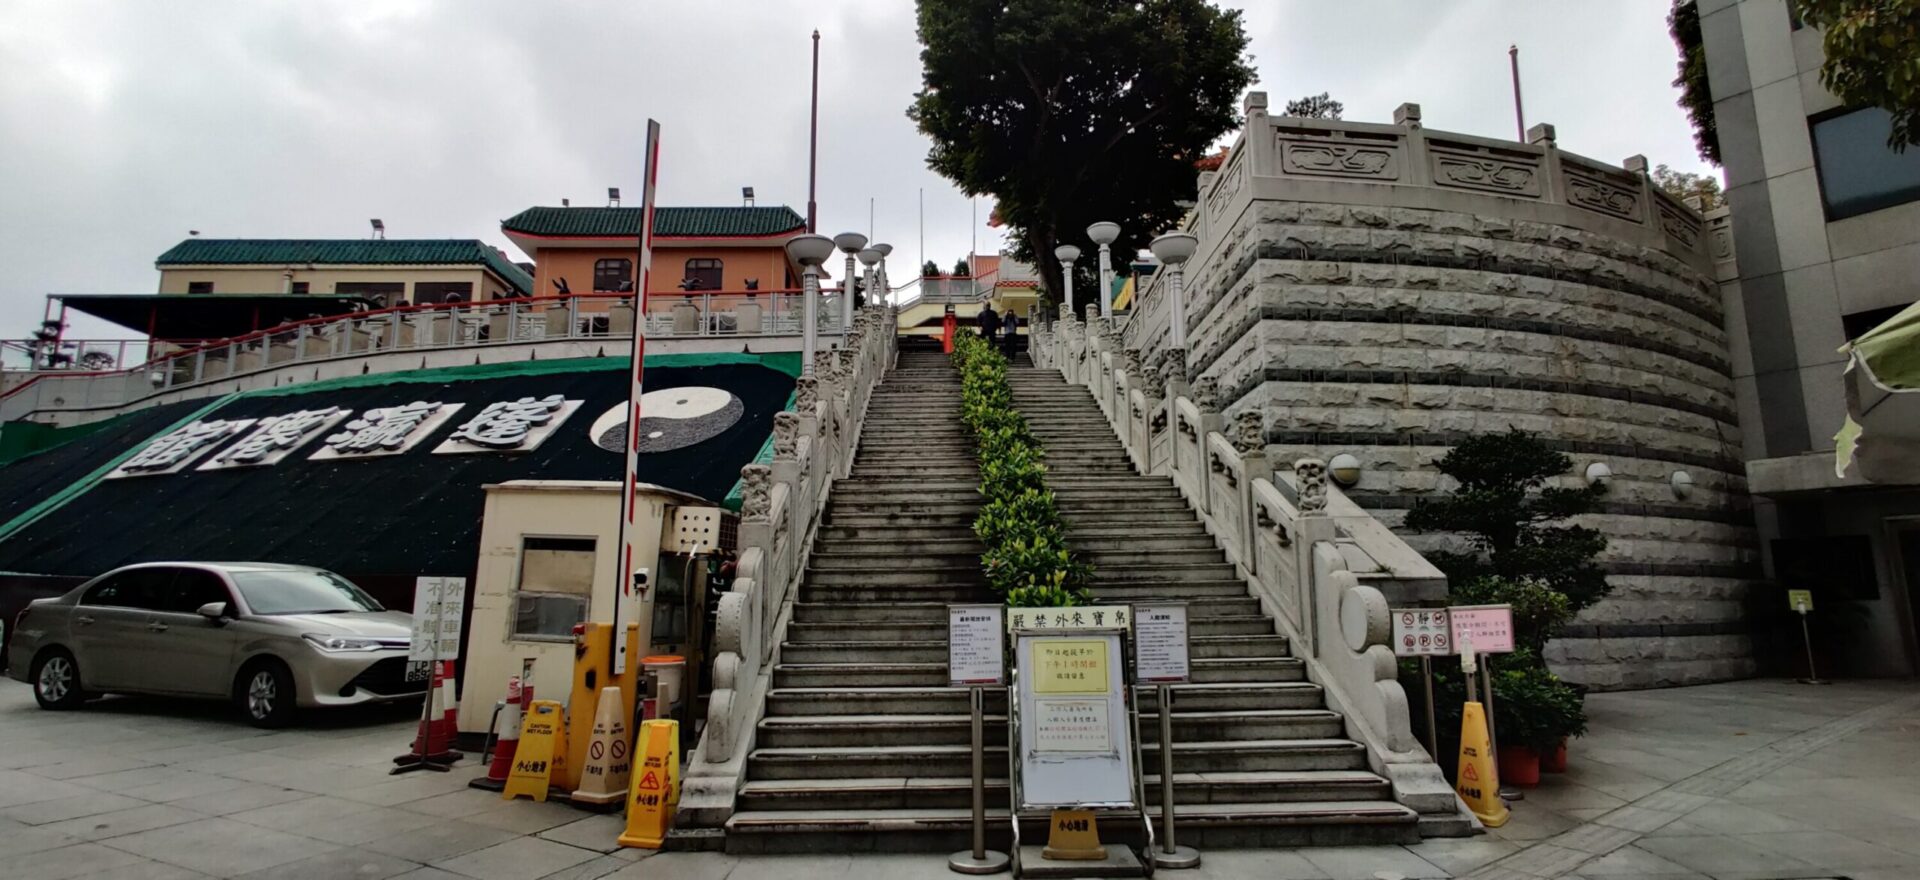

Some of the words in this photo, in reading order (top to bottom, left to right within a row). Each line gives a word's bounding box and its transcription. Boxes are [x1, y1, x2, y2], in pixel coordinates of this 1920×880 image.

[442, 582, 463, 653] 外來車輛
[517, 760, 547, 773] 小心地滑
